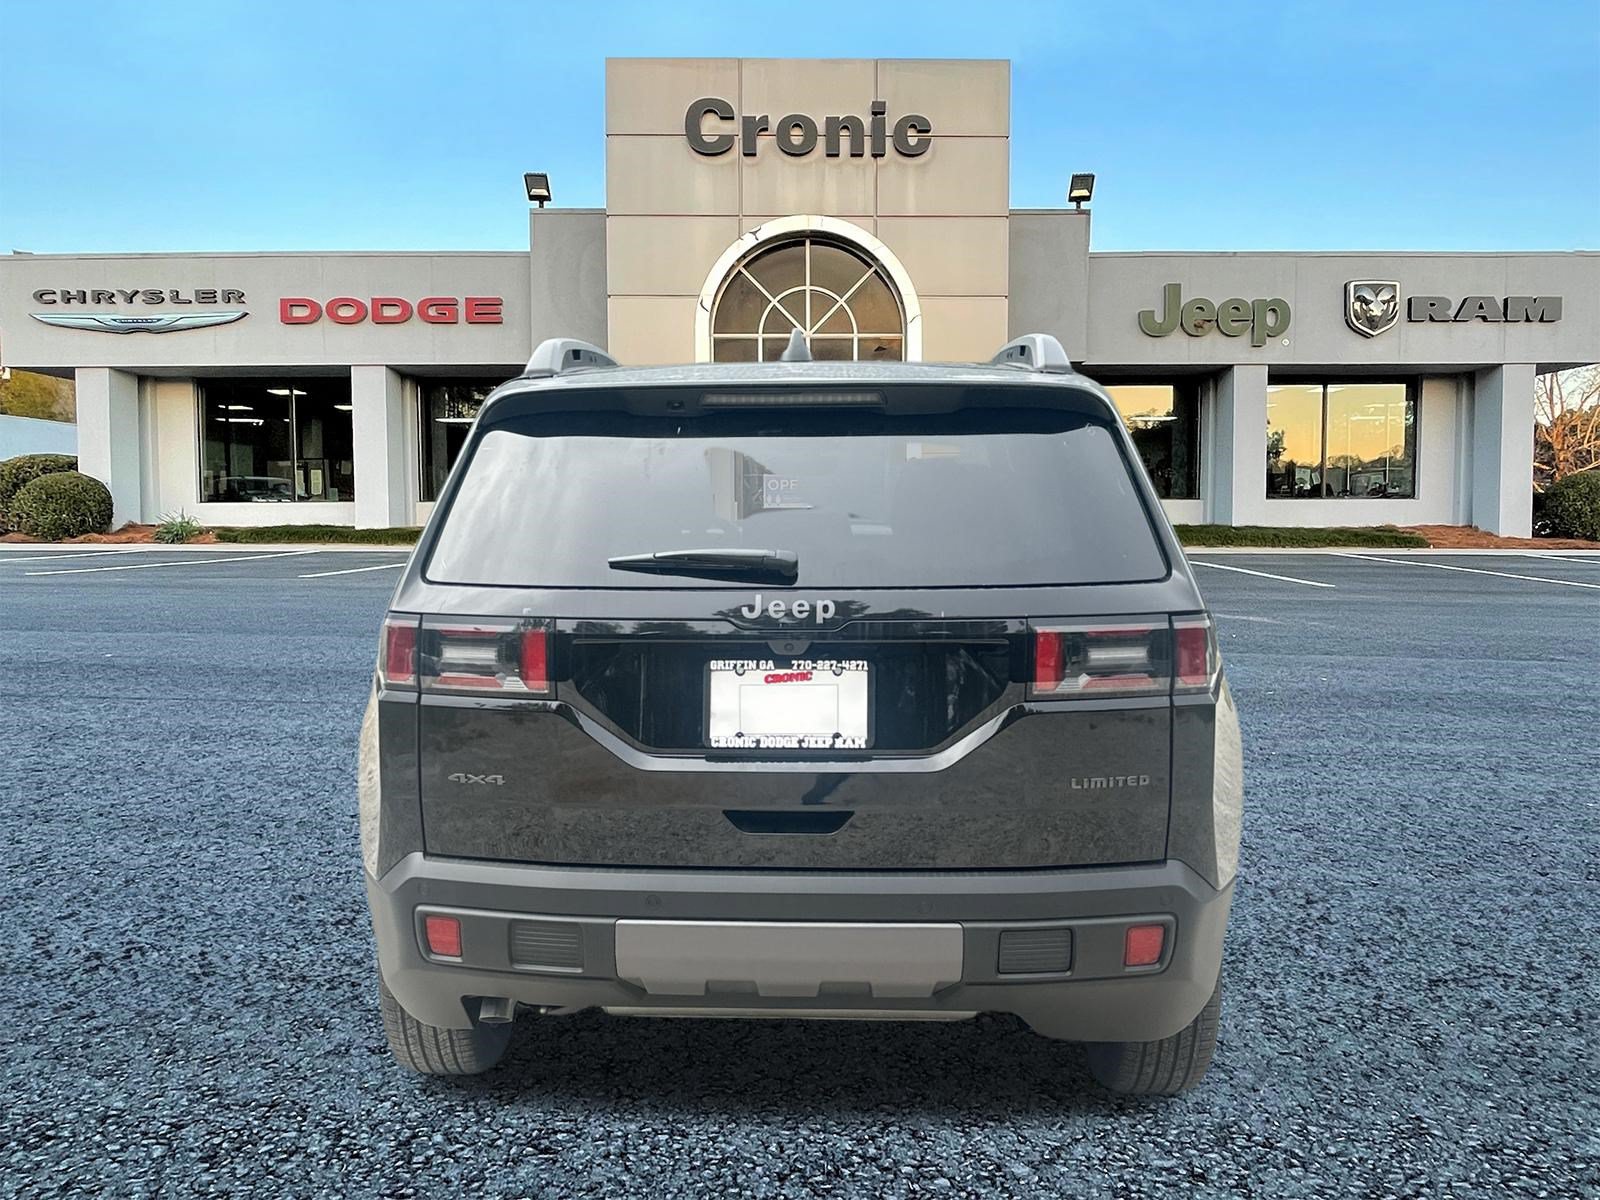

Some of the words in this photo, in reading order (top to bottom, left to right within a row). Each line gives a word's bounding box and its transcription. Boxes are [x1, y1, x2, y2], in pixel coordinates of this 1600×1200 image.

[685, 97, 932, 157] Cronic
[32, 289, 246, 305] CHRYSLER
[280, 297, 503, 324] DODGE
[1138, 283, 1291, 347] Jeep
[1407, 296, 1563, 322] RAM
[741, 594, 836, 624] Jeep
[710, 660, 757, 670] GRIFFIN
[759, 660, 775, 670] GA
[791, 660, 868, 670] 770-227-4271
[711, 736, 757, 748] CRONIC
[759, 736, 799, 748] DODGE
[801, 736, 832, 748] JEEP
[1071, 775, 1150, 789] LIMITED
